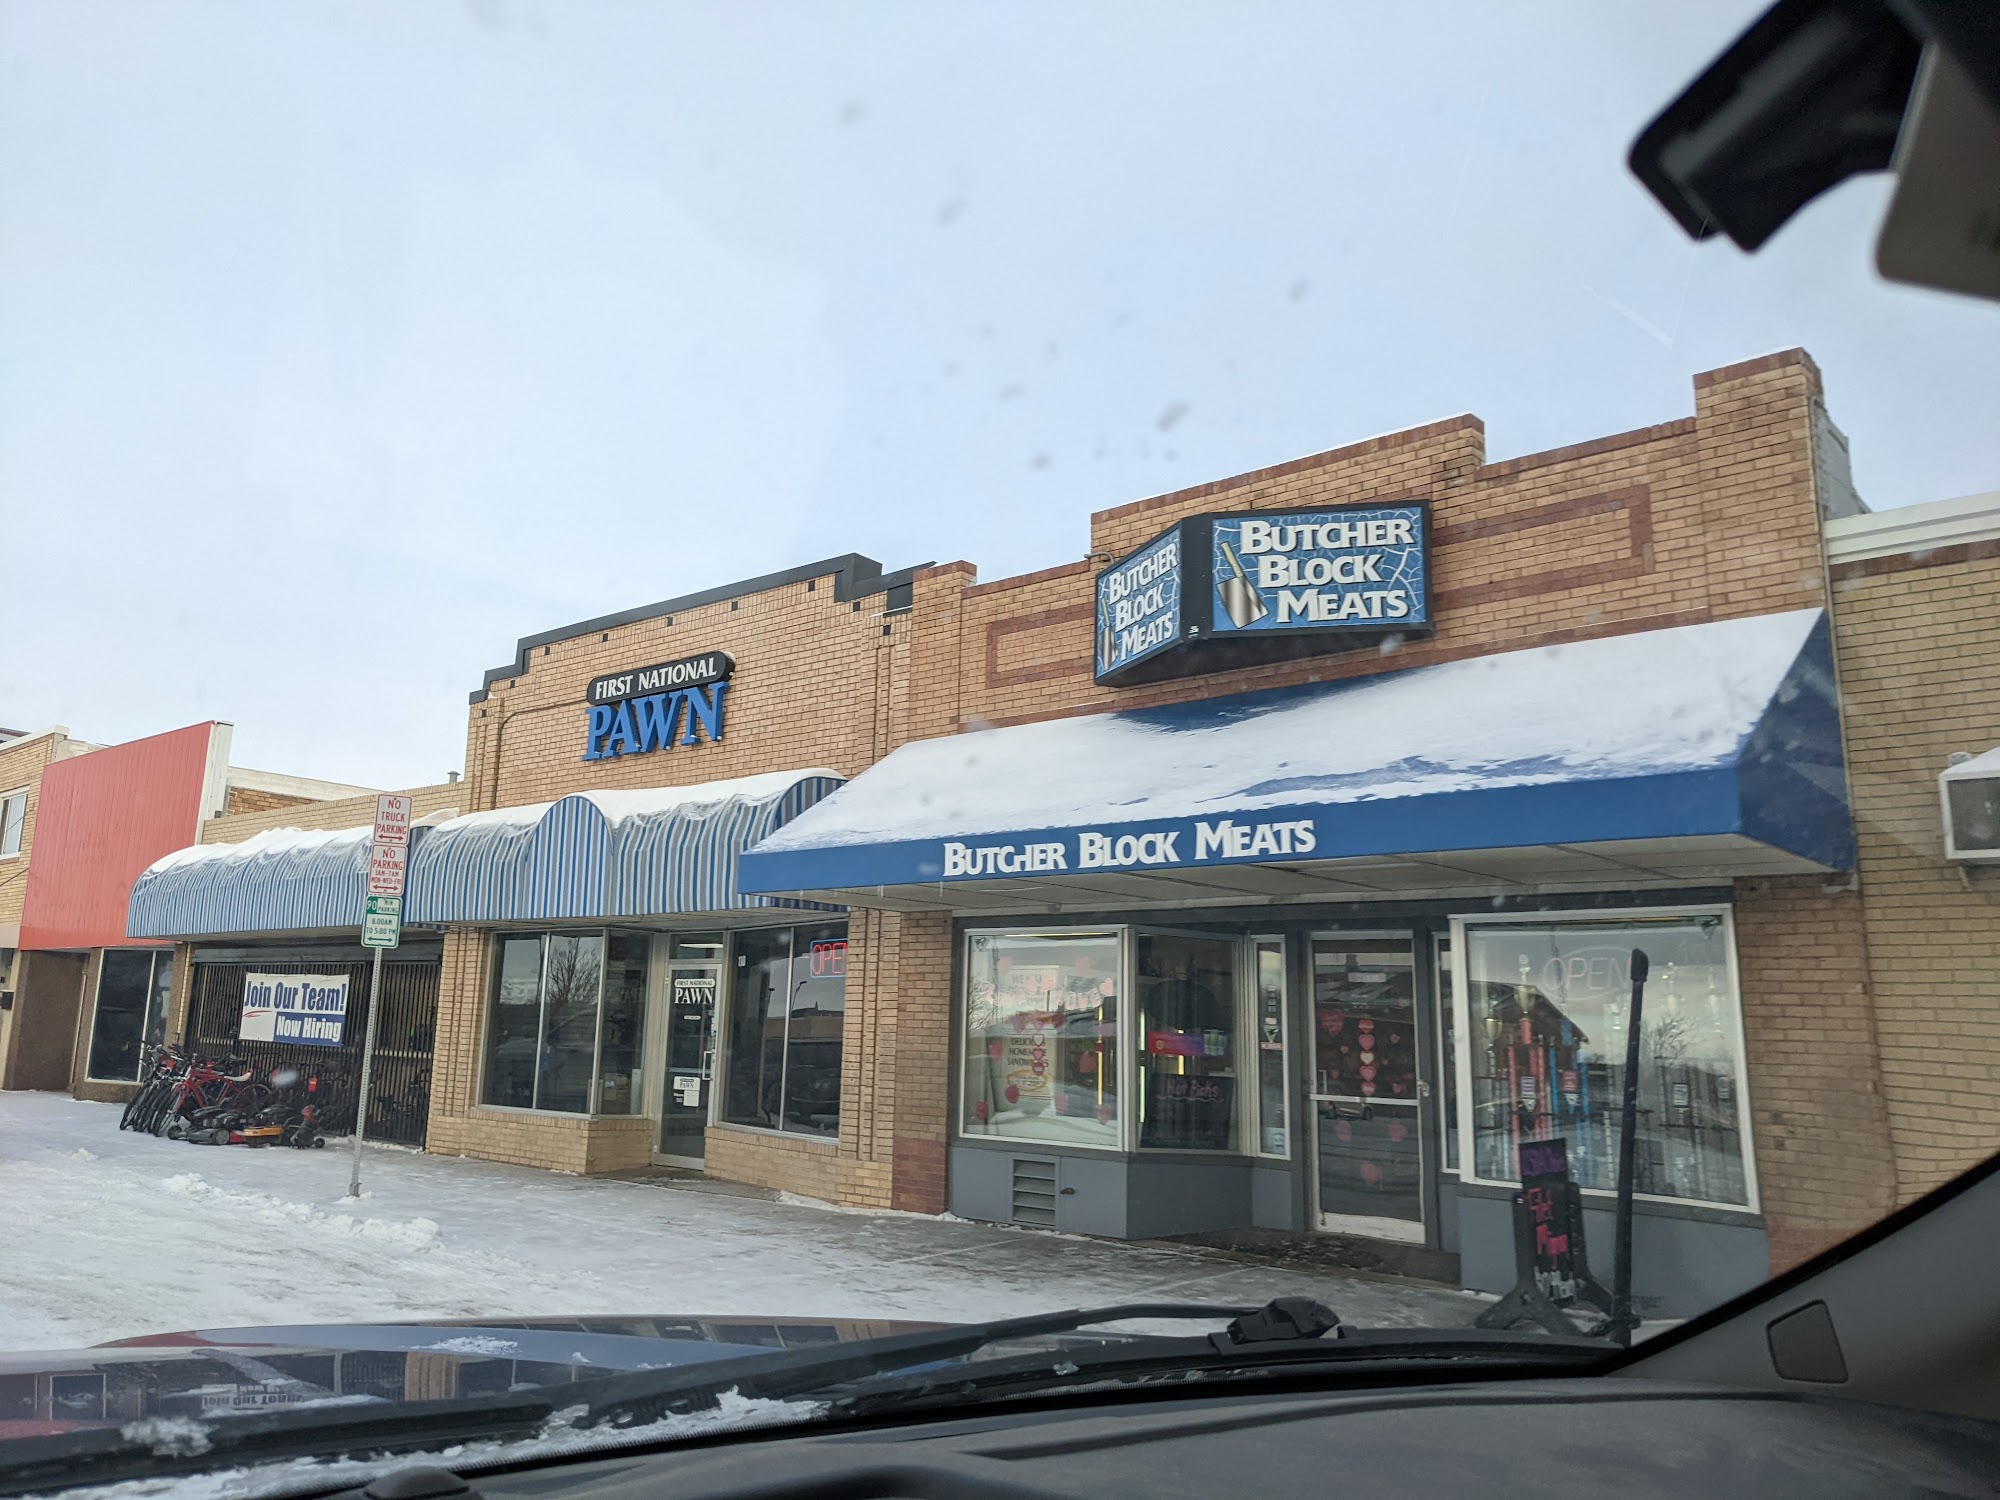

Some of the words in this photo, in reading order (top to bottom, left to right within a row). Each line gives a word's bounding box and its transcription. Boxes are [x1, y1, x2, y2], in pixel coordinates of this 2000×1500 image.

[1240, 518, 1415, 555] BUTCHER
[1109, 543, 1177, 604] BUTCHER
[1258, 554, 1384, 589] BLOCK
[1115, 585, 1166, 632] BLOCK
[1276, 589, 1409, 623] MEATS
[1120, 612, 1174, 661] MEATS
[595, 675, 633, 700] FIRST
[638, 657, 717, 691] NATIONAL
[582, 681, 730, 761] PAWN
[381, 811, 405, 822] TRUCK
[388, 800, 401, 809] NO
[376, 823, 407, 835] PARKING
[372, 859, 403, 871] PARKING
[382, 849, 395, 859] NO
[942, 842, 1068, 877] BUTCHER
[1078, 831, 1182, 868] BLOCK
[1194, 819, 1317, 860] MEATS
[367, 900, 377, 910] 90
[1542, 957, 1632, 991] OPEN
[244, 981, 272, 1008] Join
[273, 982, 299, 1010] Our
[301, 983, 347, 1012] Team!
[674, 988, 714, 1004] PAWN
[276, 1016, 301, 1037] Now
[302, 1017, 342, 1043] Hiring
